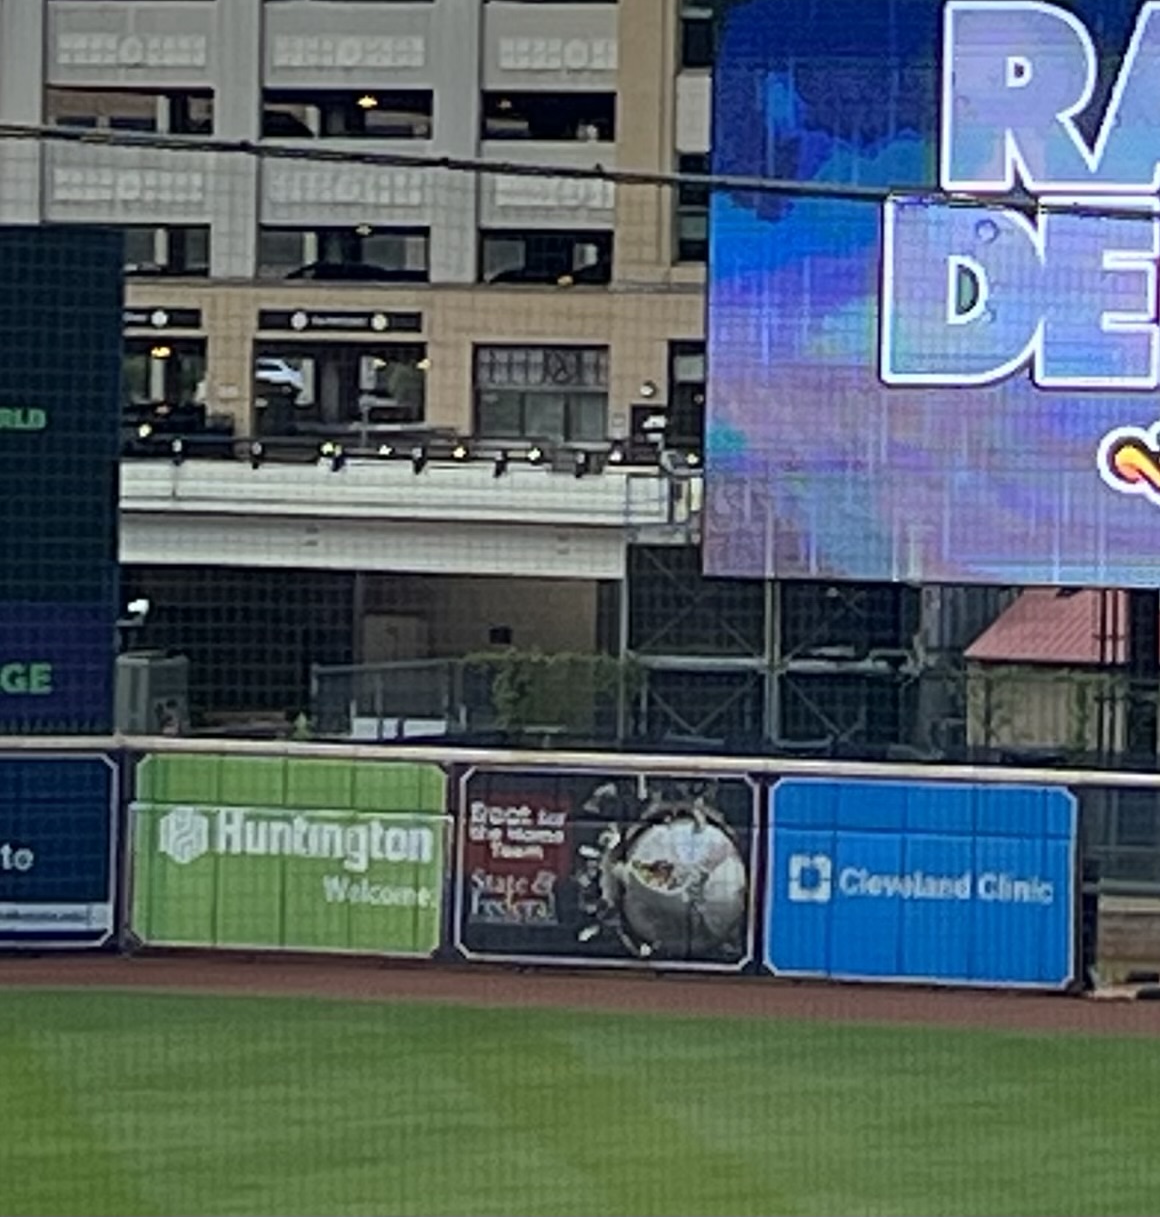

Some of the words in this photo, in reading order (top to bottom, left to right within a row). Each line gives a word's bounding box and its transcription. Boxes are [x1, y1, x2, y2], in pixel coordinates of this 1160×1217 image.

[217, 811, 433, 872] Huntington
[839, 868, 971, 900] Cleveland
[978, 873, 1054, 904] Clinic
